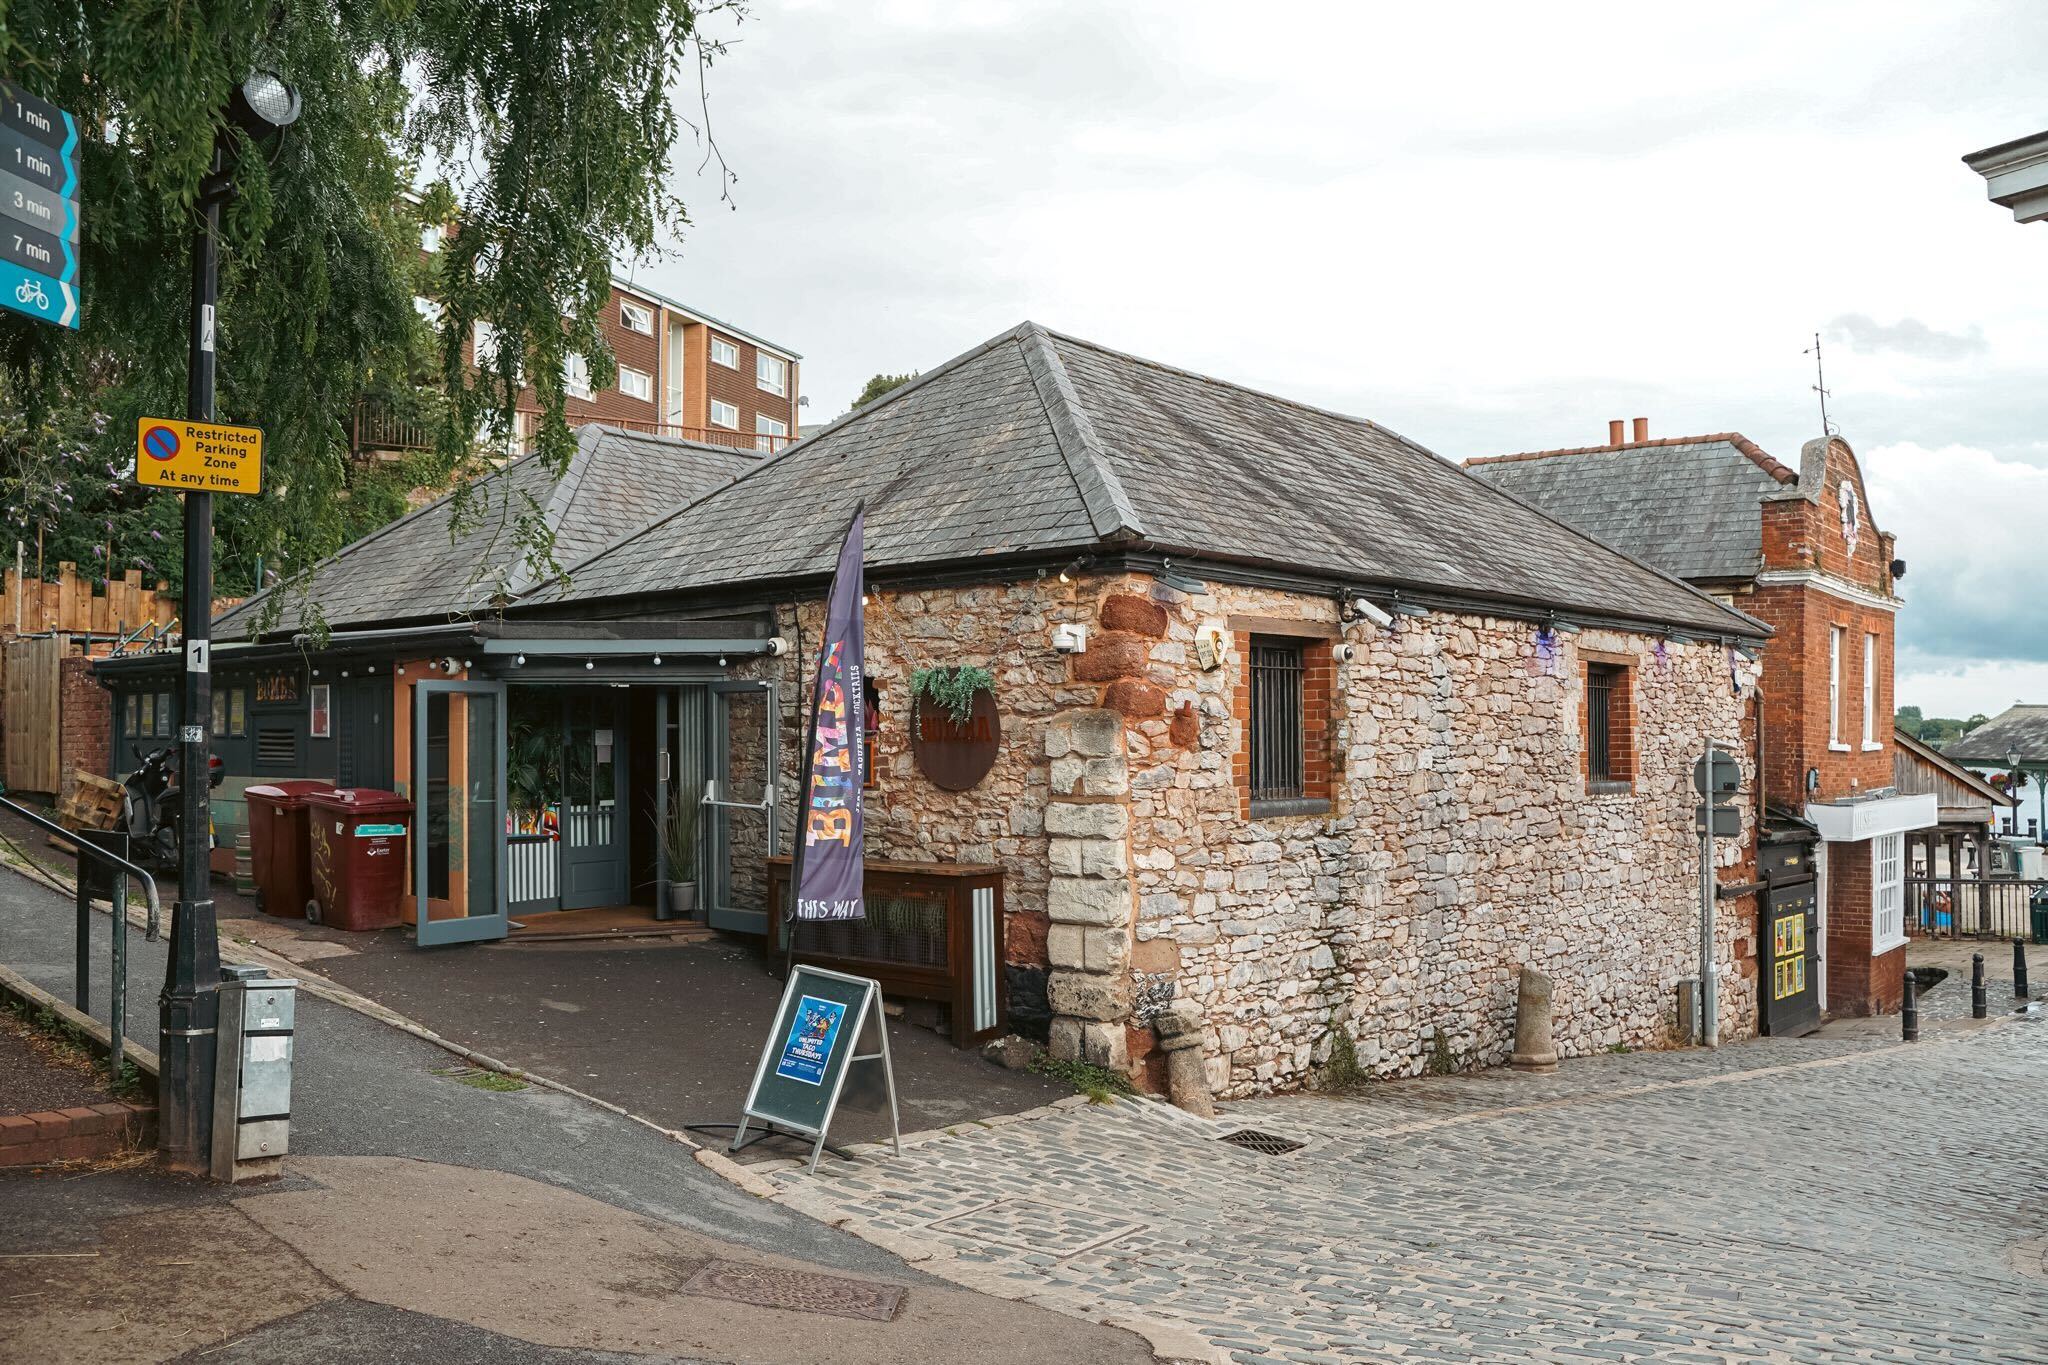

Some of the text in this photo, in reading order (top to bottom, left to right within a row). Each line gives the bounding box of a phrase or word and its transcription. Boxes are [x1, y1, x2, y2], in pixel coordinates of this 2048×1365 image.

[16, 103, 50, 132] 1 min
[15, 147, 51, 177] 1 min
[14, 191, 51, 220] 3 min
[13, 234, 50, 263] 7 min
[186, 427, 257, 444] Restricted
[195, 442, 247, 458] Parking
[204, 456, 237, 469] Zone
[160, 470, 240, 487] At any time
[192, 646, 202, 664] 1
[798, 898, 859, 919] THIS WAY
[803, 1043, 816, 1052] TACO
